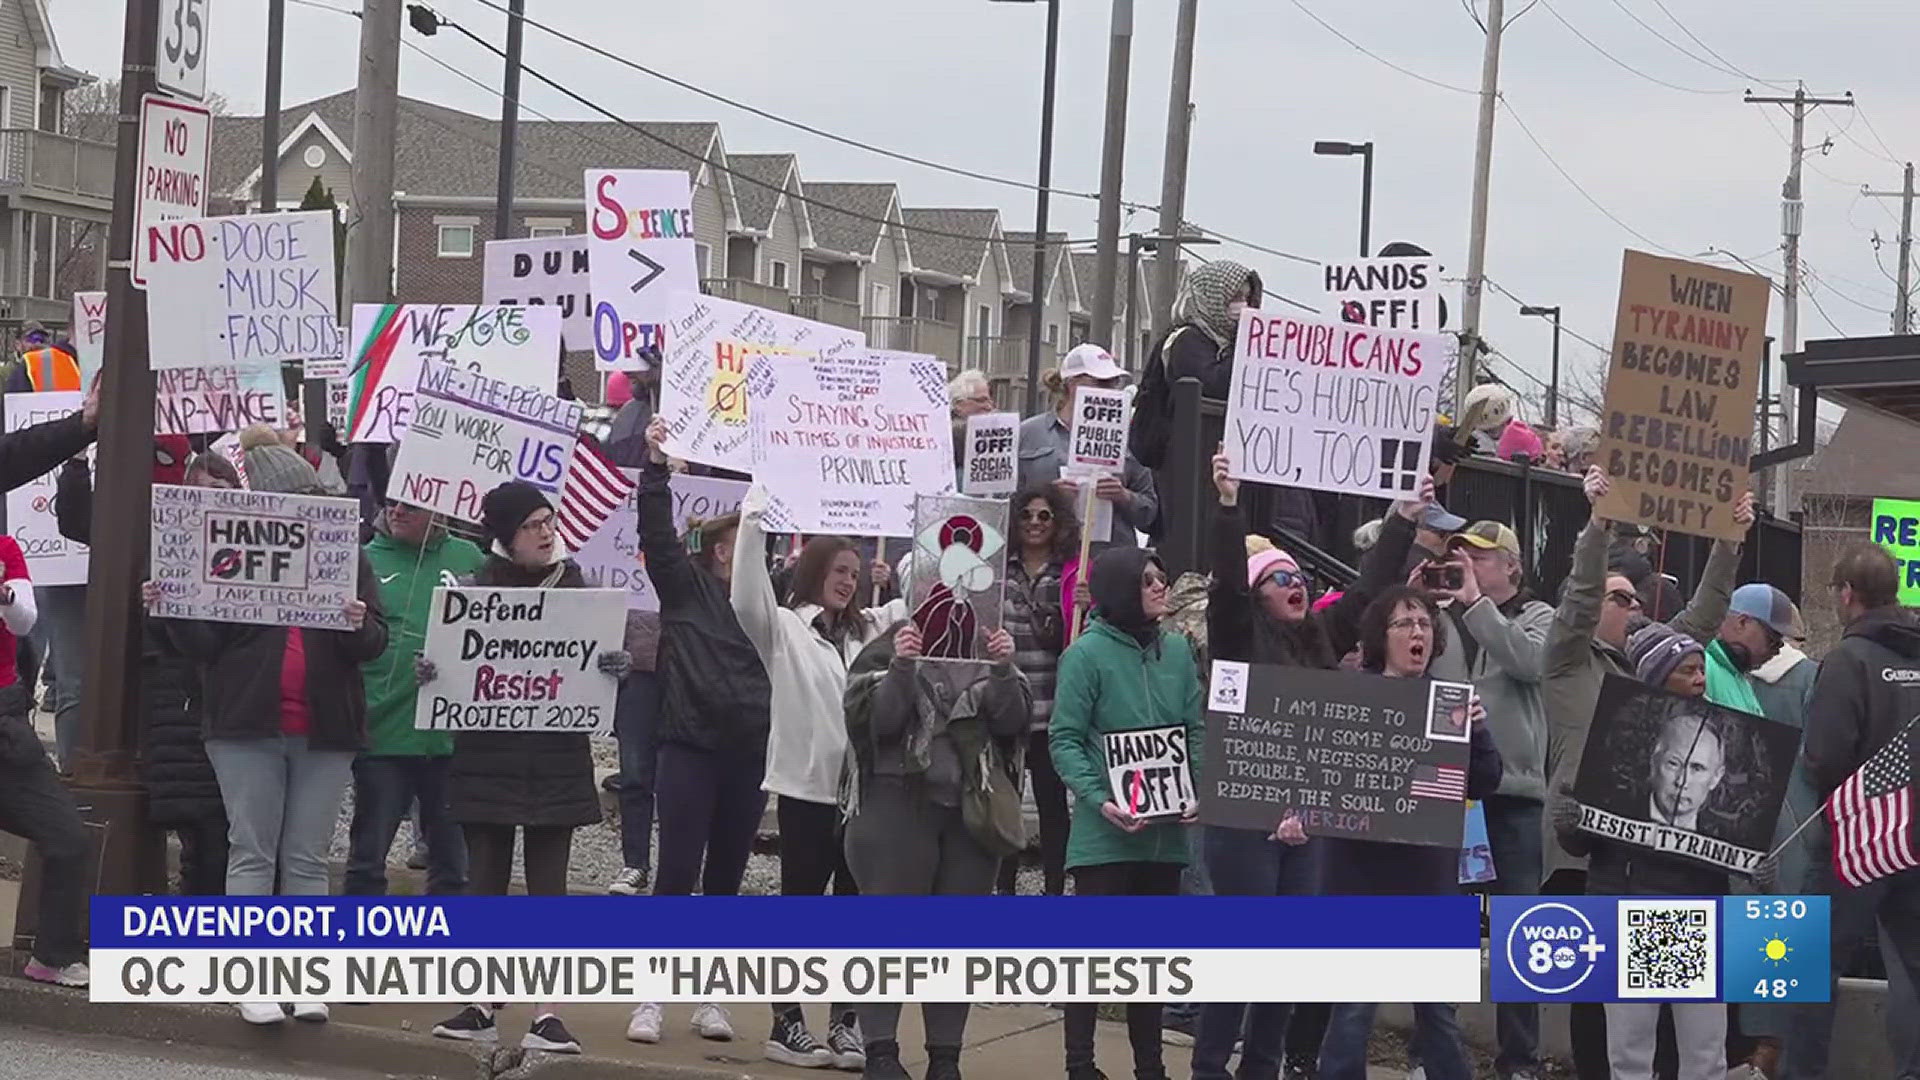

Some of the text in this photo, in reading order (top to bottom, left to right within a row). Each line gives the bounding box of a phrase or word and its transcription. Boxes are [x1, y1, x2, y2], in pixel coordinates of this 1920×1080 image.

[165, 0, 202, 69] 35
[164, 119, 188, 156] NO
[146, 166, 200, 207] PARKING
[592, 175, 694, 240] SCIENCE
[149, 220, 308, 262] NO DOGE
[513, 248, 589, 278] DUM
[1325, 263, 1429, 291] HANDS
[226, 268, 329, 313] MUSK
[1669, 274, 1733, 314] WHEN
[410, 307, 455, 347] WE
[594, 302, 665, 362] OPIN
[1341, 299, 1420, 330] OFF!
[1629, 304, 1749, 352] TYRANNY
[1247, 315, 1422, 377] REPUBLICANS
[157, 367, 238, 394] MPEACH
[1621, 341, 1741, 390] BECOMES
[469, 372, 506, 405] THE
[510, 385, 583, 430] PEOPLE
[787, 394, 929, 433] STAYING SILENT
[1083, 407, 1122, 424] OFF!
[1084, 395, 1123, 408] HANDS
[1239, 365, 1433, 434] HE'S HURTING
[1659, 385, 1718, 429] LAW,
[414, 400, 504, 446] YOU WORK
[975, 427, 1014, 439] HANDS
[1077, 425, 1123, 443] PUBLIC
[473, 443, 513, 475] FOR
[770, 430, 790, 446] IN
[794, 430, 841, 448] TIMES
[845, 434, 860, 450] OF
[866, 436, 925, 453] INJUSTICE
[974, 438, 1013, 455] OFF!
[1075, 440, 1122, 459] LANDS
[1236, 418, 1303, 482] YOU,
[517, 437, 564, 484] US
[970, 457, 1012, 472] SOCIAL
[970, 470, 1012, 482] SECURITY
[1608, 449, 1735, 503] BECOMES
[214, 491, 287, 512] SECURITY
[402, 472, 449, 502] NOT
[1639, 491, 1713, 529] DUTY
[15, 526, 68, 553] Social
[210, 519, 305, 549] HANDS
[210, 548, 292, 583] OFF
[259, 588, 345, 605] ELECTIONS
[442, 590, 545, 625] Defend
[461, 628, 598, 671] Democracy
[430, 697, 600, 729] PROJECT 2025
[1273, 697, 1406, 727] I AM HERE TO
[1107, 729, 1186, 769] HANDS
[1226, 716, 1433, 753] ENGAGE IN SOME GOOD
[1223, 738, 1414, 774] TROUBLE, NECESSARY
[1121, 765, 1188, 815] OFF!
[1217, 780, 1418, 814] REDEEM THE SOUL OF
[1321, 768, 1343, 787] TO
[1354, 771, 1405, 791] HELP
[1284, 807, 1371, 831] AMERICA
[1582, 807, 1653, 846] RESIST
